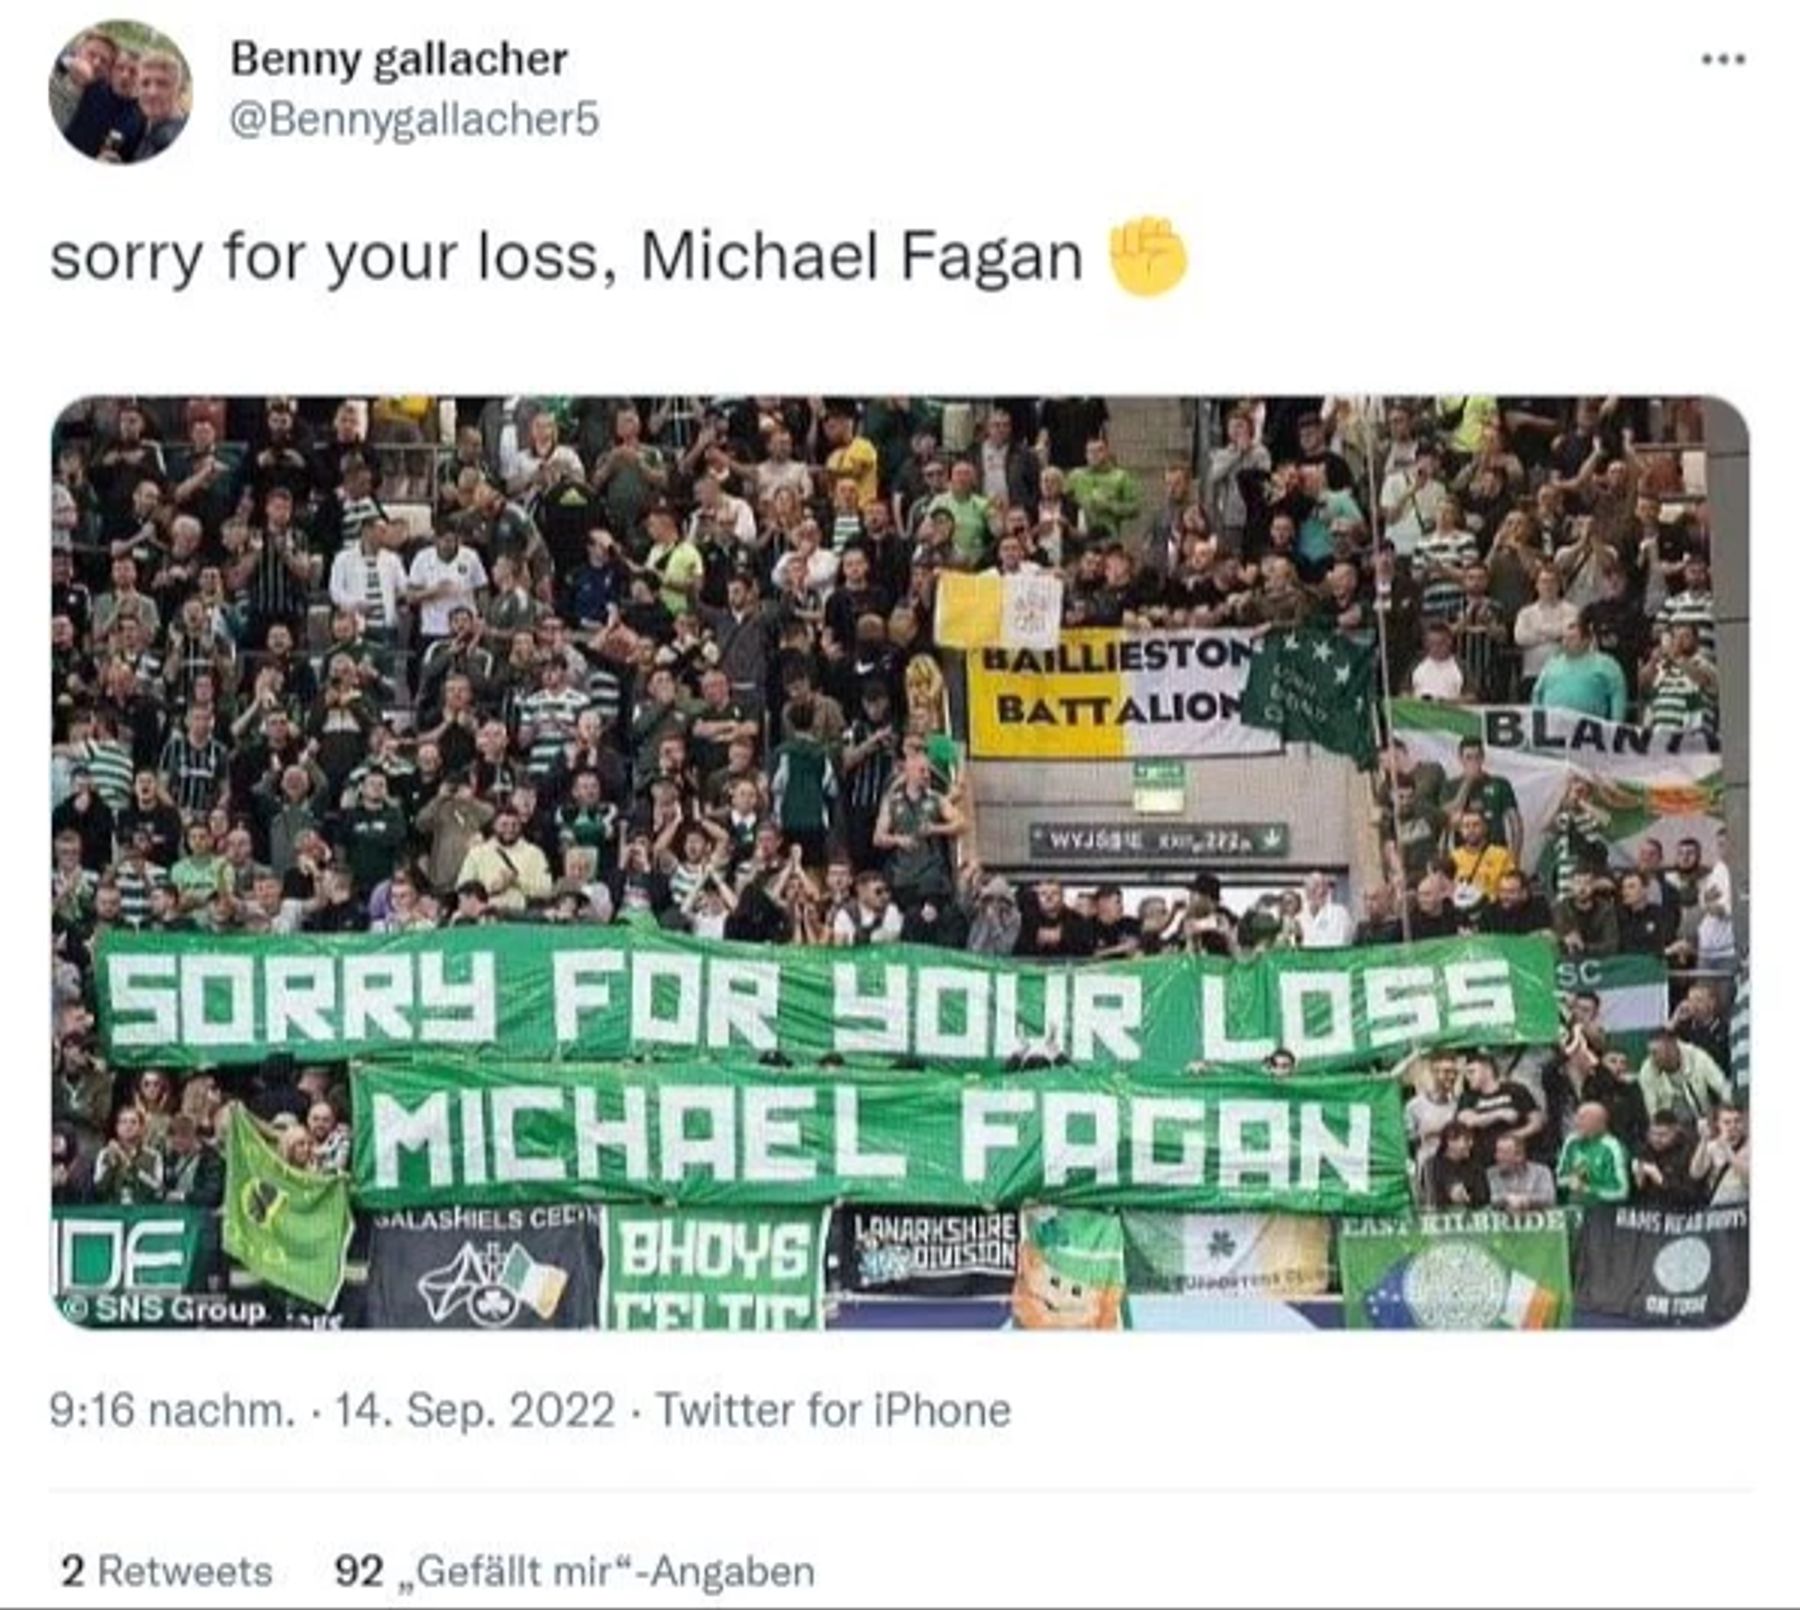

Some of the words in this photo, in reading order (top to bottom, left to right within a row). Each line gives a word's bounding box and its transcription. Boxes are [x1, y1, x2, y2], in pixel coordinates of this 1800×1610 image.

[231, 39, 363, 85] Benny
[373, 39, 569, 85] gallacher
[230, 99, 600, 145] @Bennygallacher5
[51, 241, 204, 293] sorry
[222, 229, 307, 281] for
[325, 241, 459, 293] your
[480, 229, 616, 290] loss,
[643, 227, 877, 281] Michael
[903, 229, 1082, 293] Fagan
[997, 692, 1242, 725] BATTALION
[106, 950, 496, 1046] SORRY
[553, 949, 781, 1049] FOR
[833, 962, 1144, 1060] YOUR
[1202, 958, 1518, 1061] LOSS
[372, 1084, 908, 1188] MICHAEL
[960, 1087, 1372, 1194] FAGAN
[617, 1217, 812, 1280] BHOYS
[854, 1212, 1016, 1243] LANARKSHIRE
[914, 1240, 1016, 1271] DIVISION
[50, 1390, 135, 1428] 9:16
[149, 1392, 295, 1428] nachm.
[337, 1391, 392, 1427] 14.
[407, 1390, 495, 1435] Sep.
[510, 1390, 615, 1428] 2022
[655, 1390, 795, 1428] Twitter
[807, 1391, 863, 1428] for
[875, 1390, 1011, 1428] iPhone
[61, 1553, 86, 1588] 2
[99, 1553, 273, 1588] Retweets
[334, 1552, 384, 1588] 92
